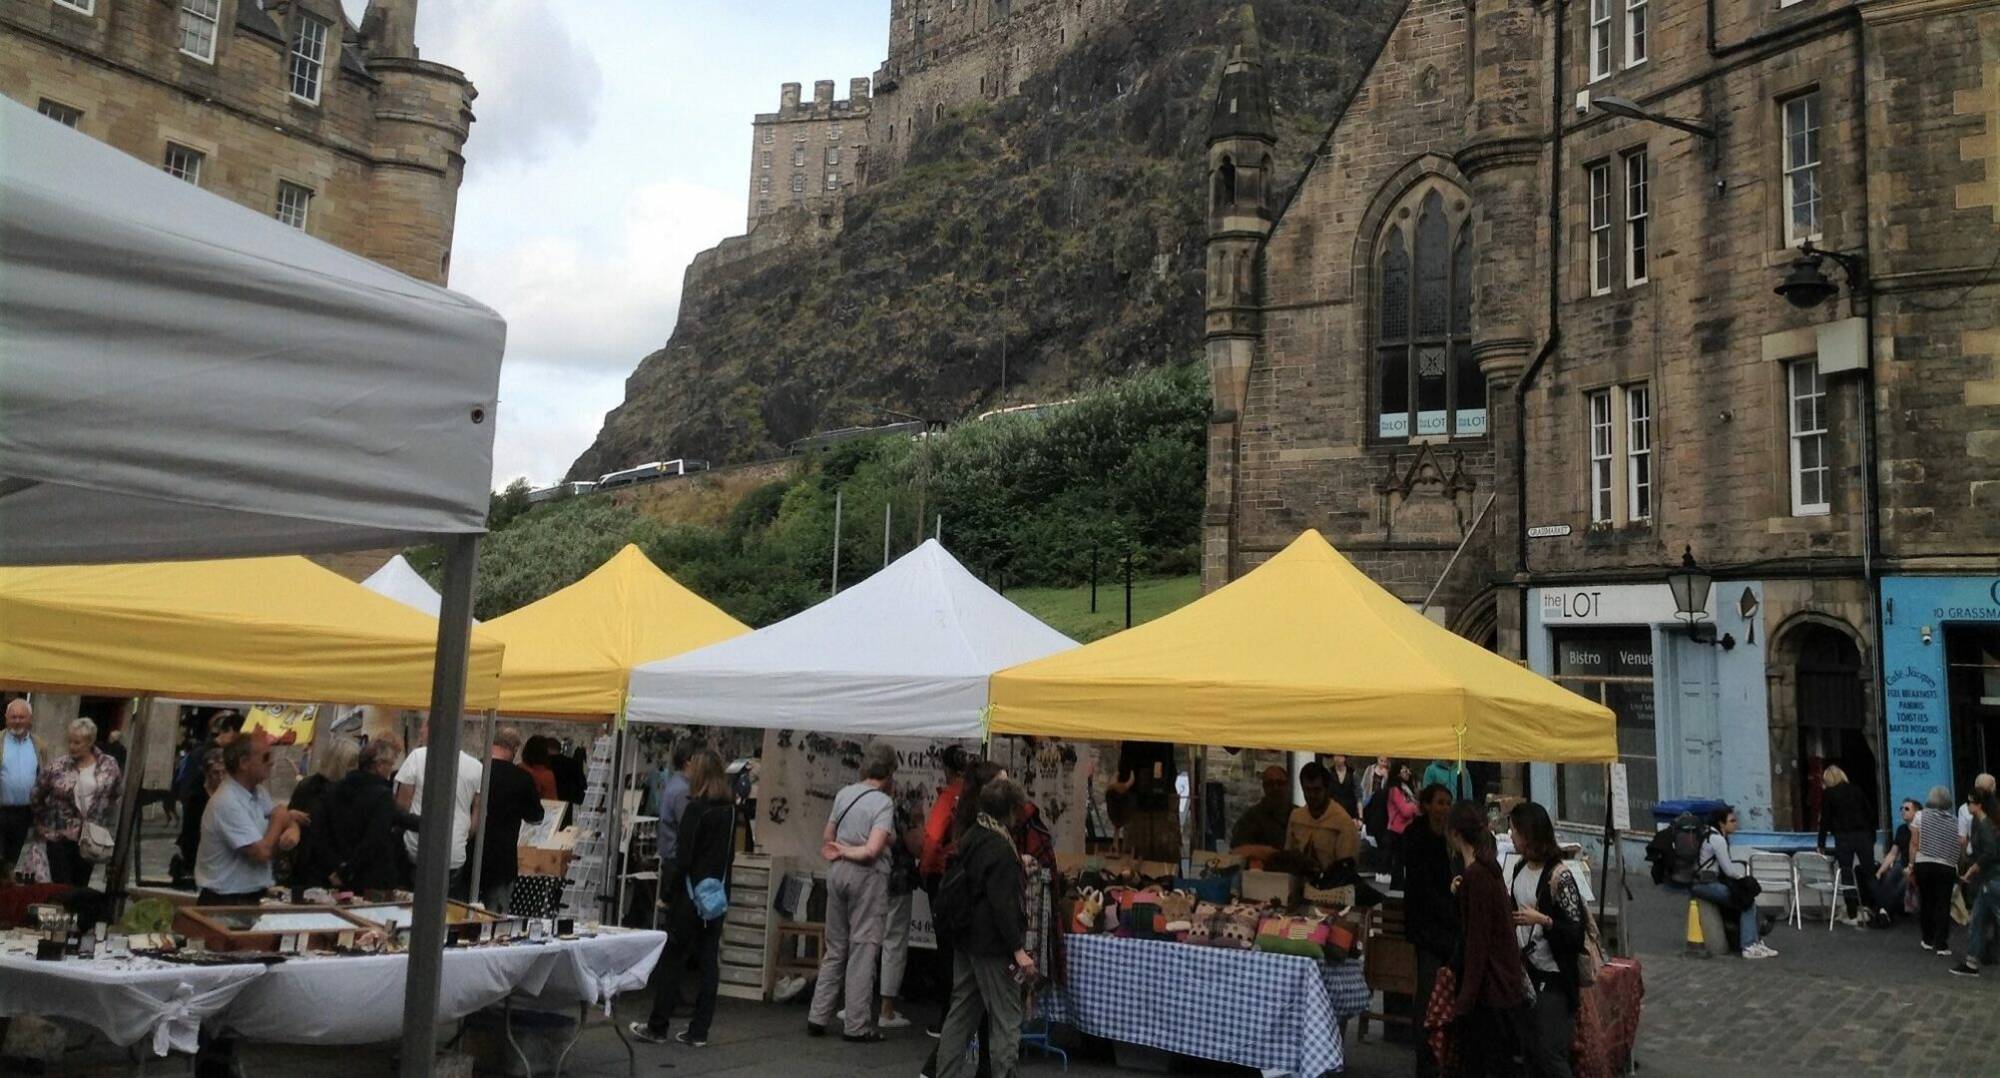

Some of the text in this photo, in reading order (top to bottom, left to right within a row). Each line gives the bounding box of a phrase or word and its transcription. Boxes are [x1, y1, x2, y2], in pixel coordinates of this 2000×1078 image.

[1390, 420, 1407, 430] LOT
[1428, 418, 1445, 428] LOT
[1468, 416, 1485, 426] LOT
[1530, 527, 1568, 536] GRASSMARKET
[1544, 592, 1601, 617] the LOT
[1569, 651, 1656, 665] Bistro Venue
[1901, 737, 1928, 746] SALADS
[1917, 749, 1936, 758] CHIPS
[1899, 760, 1930, 770] BURGERS
